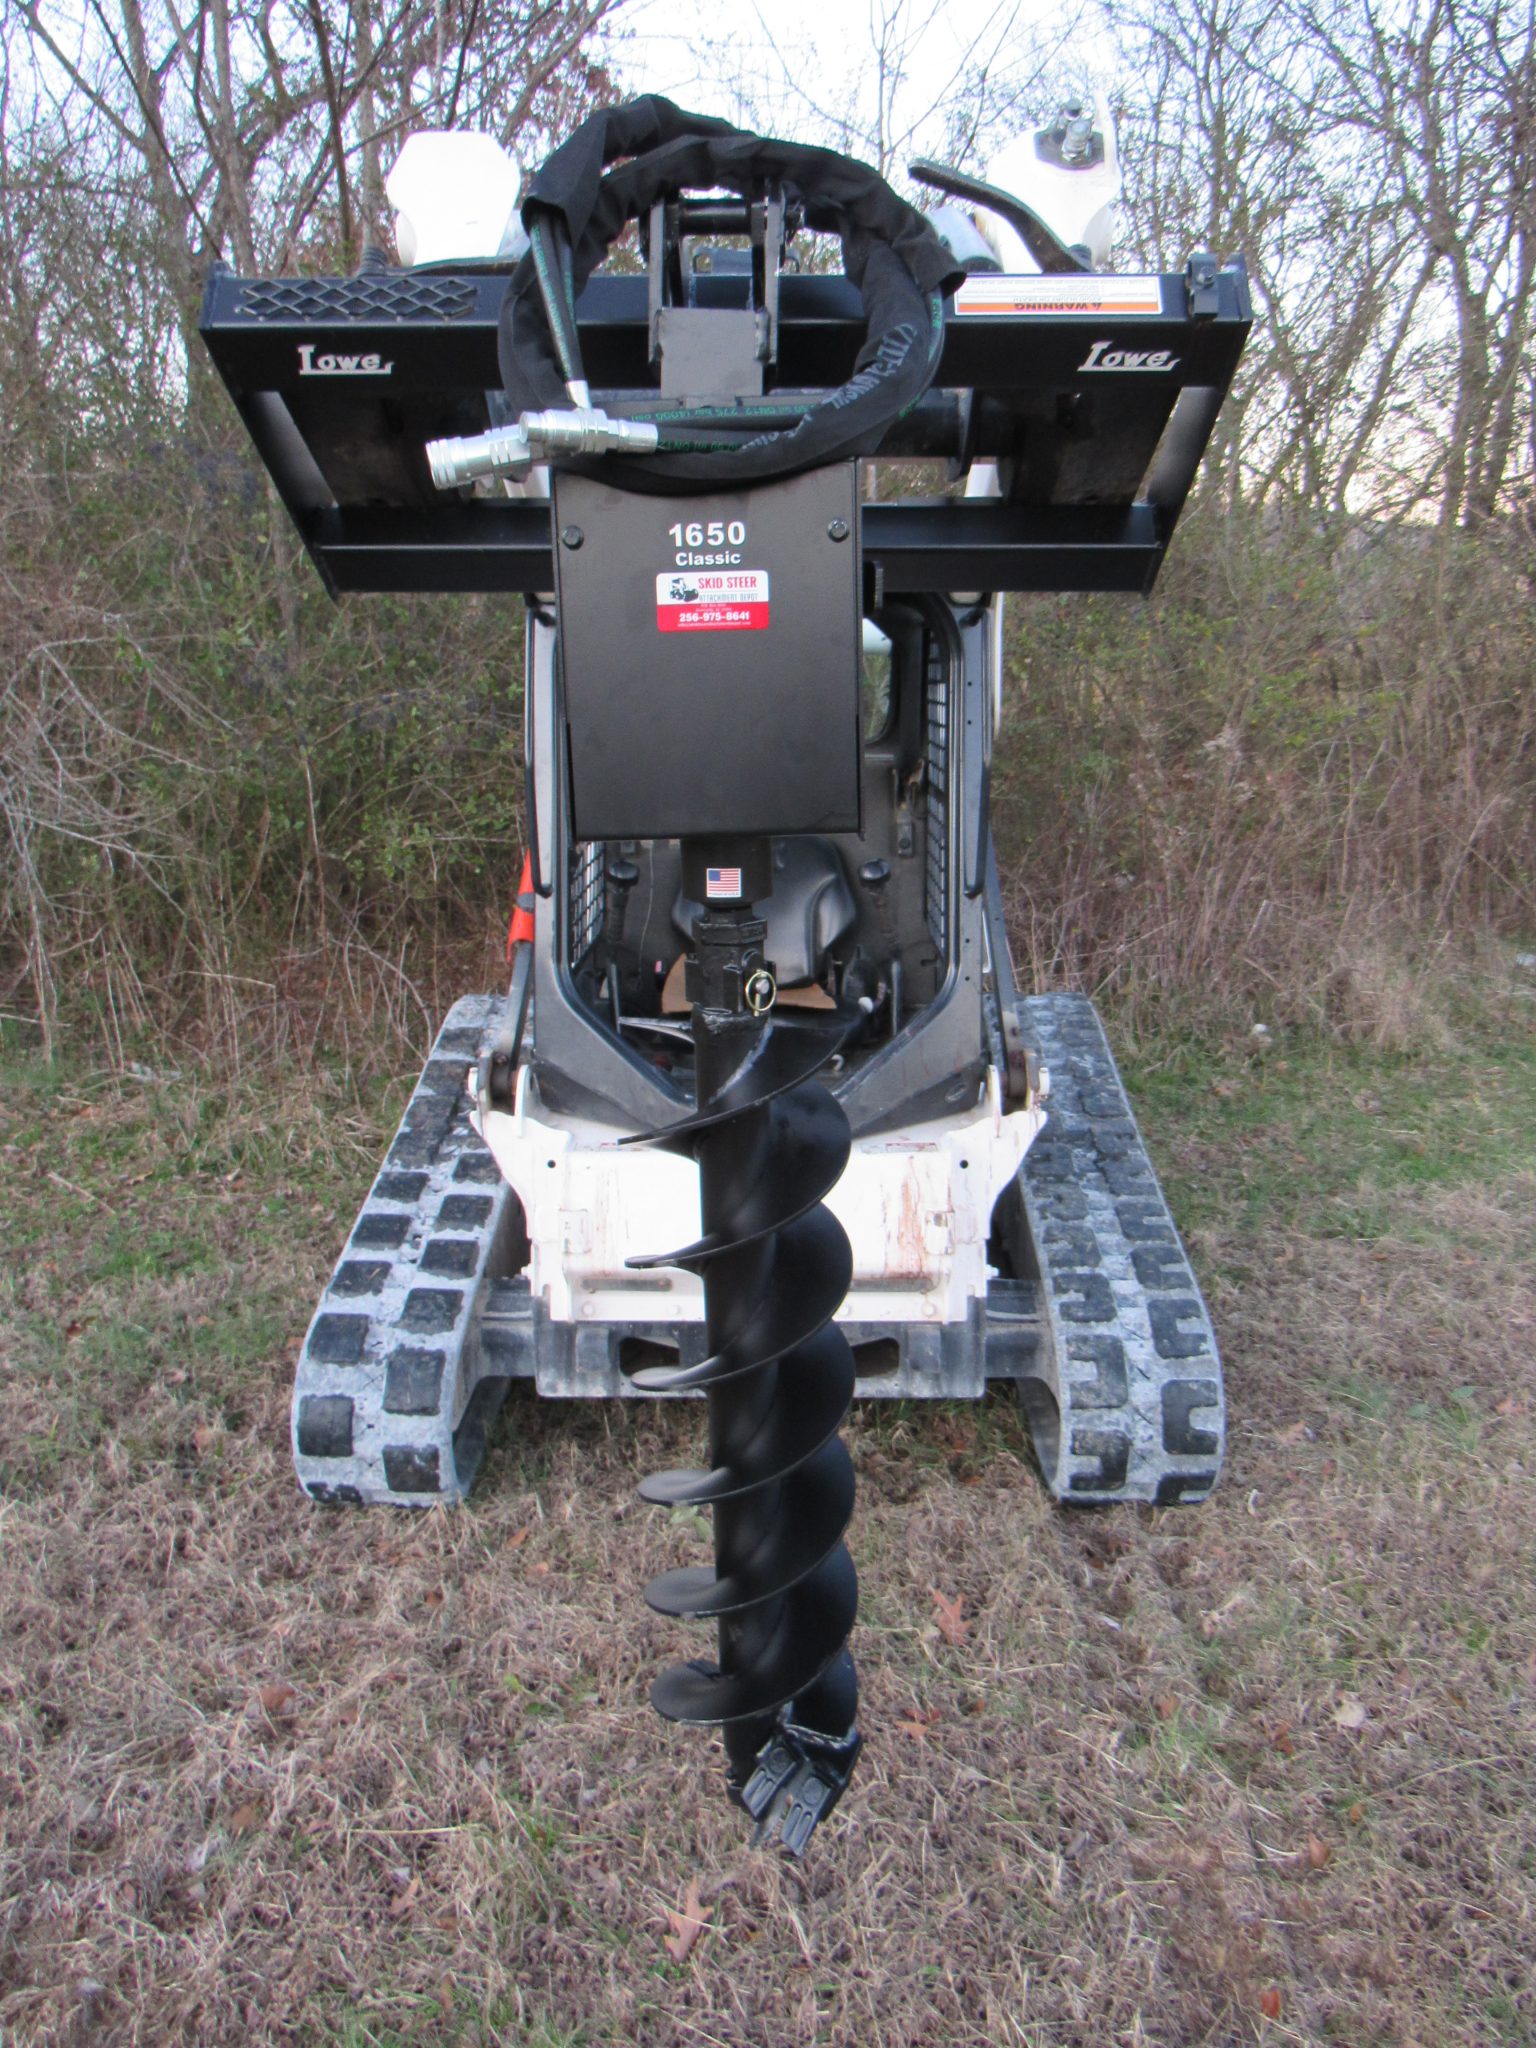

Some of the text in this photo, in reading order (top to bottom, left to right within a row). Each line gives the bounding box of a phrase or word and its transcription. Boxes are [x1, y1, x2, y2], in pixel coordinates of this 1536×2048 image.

[1013, 302, 1088, 312] WARNING
[298, 345, 394, 375] Lowe
[1077, 341, 1181, 371] Lowe
[669, 521, 745, 547] 1650
[675, 550, 741, 567] Classic
[698, 576, 757, 589] SKID STEER
[699, 592, 758, 602] ATTACHMENT DEPOT
[679, 611, 750, 623] 256-975-8641
